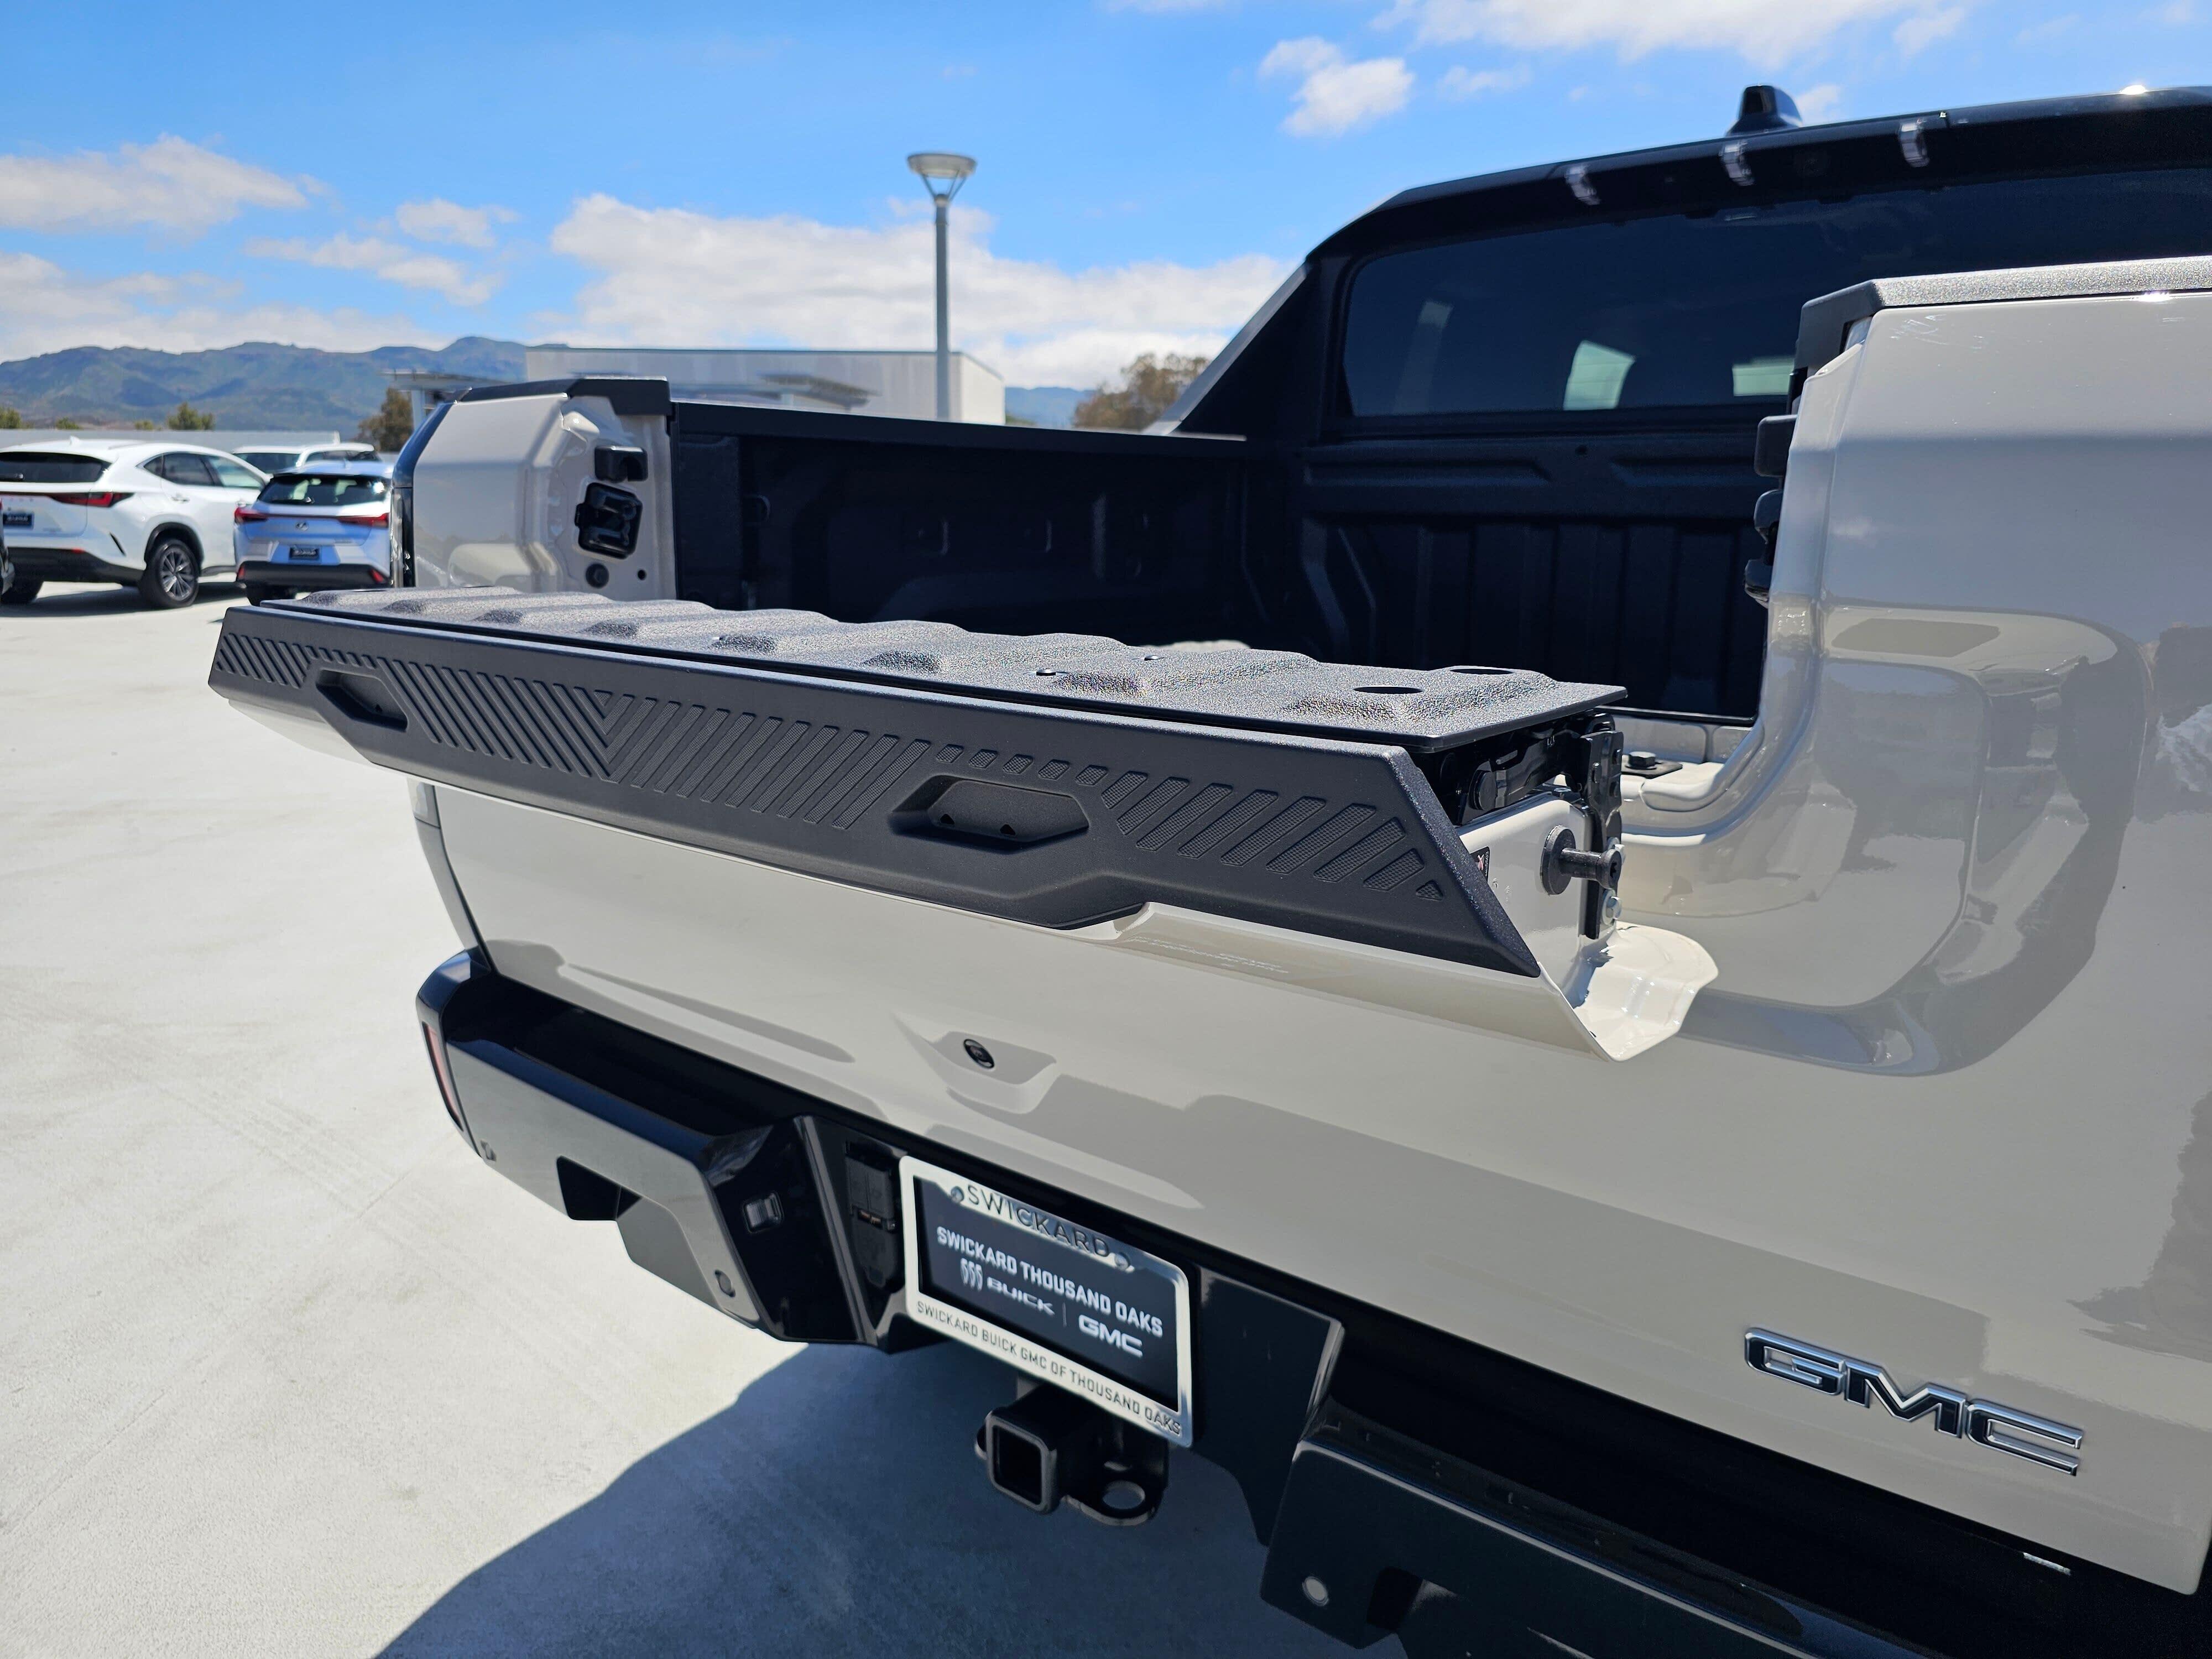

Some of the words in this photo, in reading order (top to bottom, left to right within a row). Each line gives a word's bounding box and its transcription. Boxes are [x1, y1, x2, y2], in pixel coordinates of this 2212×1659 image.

[967, 1183, 1109, 1257] SWICKARD
[936, 1225, 1018, 1276] SWICKARD
[1019, 1260, 1112, 1316] THOUSAND
[1115, 1301, 1163, 1338] OAKS
[987, 1276, 1055, 1316] BUICK
[1078, 1314, 1143, 1357] GMC
[917, 1300, 978, 1337] SWICKARD
[982, 1328, 1018, 1356] BUICK
[1020, 1347, 1047, 1369] GMC
[1051, 1361, 1067, 1377] OF
[1070, 1369, 1141, 1415] THOUSAND
[1144, 1406, 1181, 1435] OAKS
[1744, 1327, 2084, 1476] GMC
